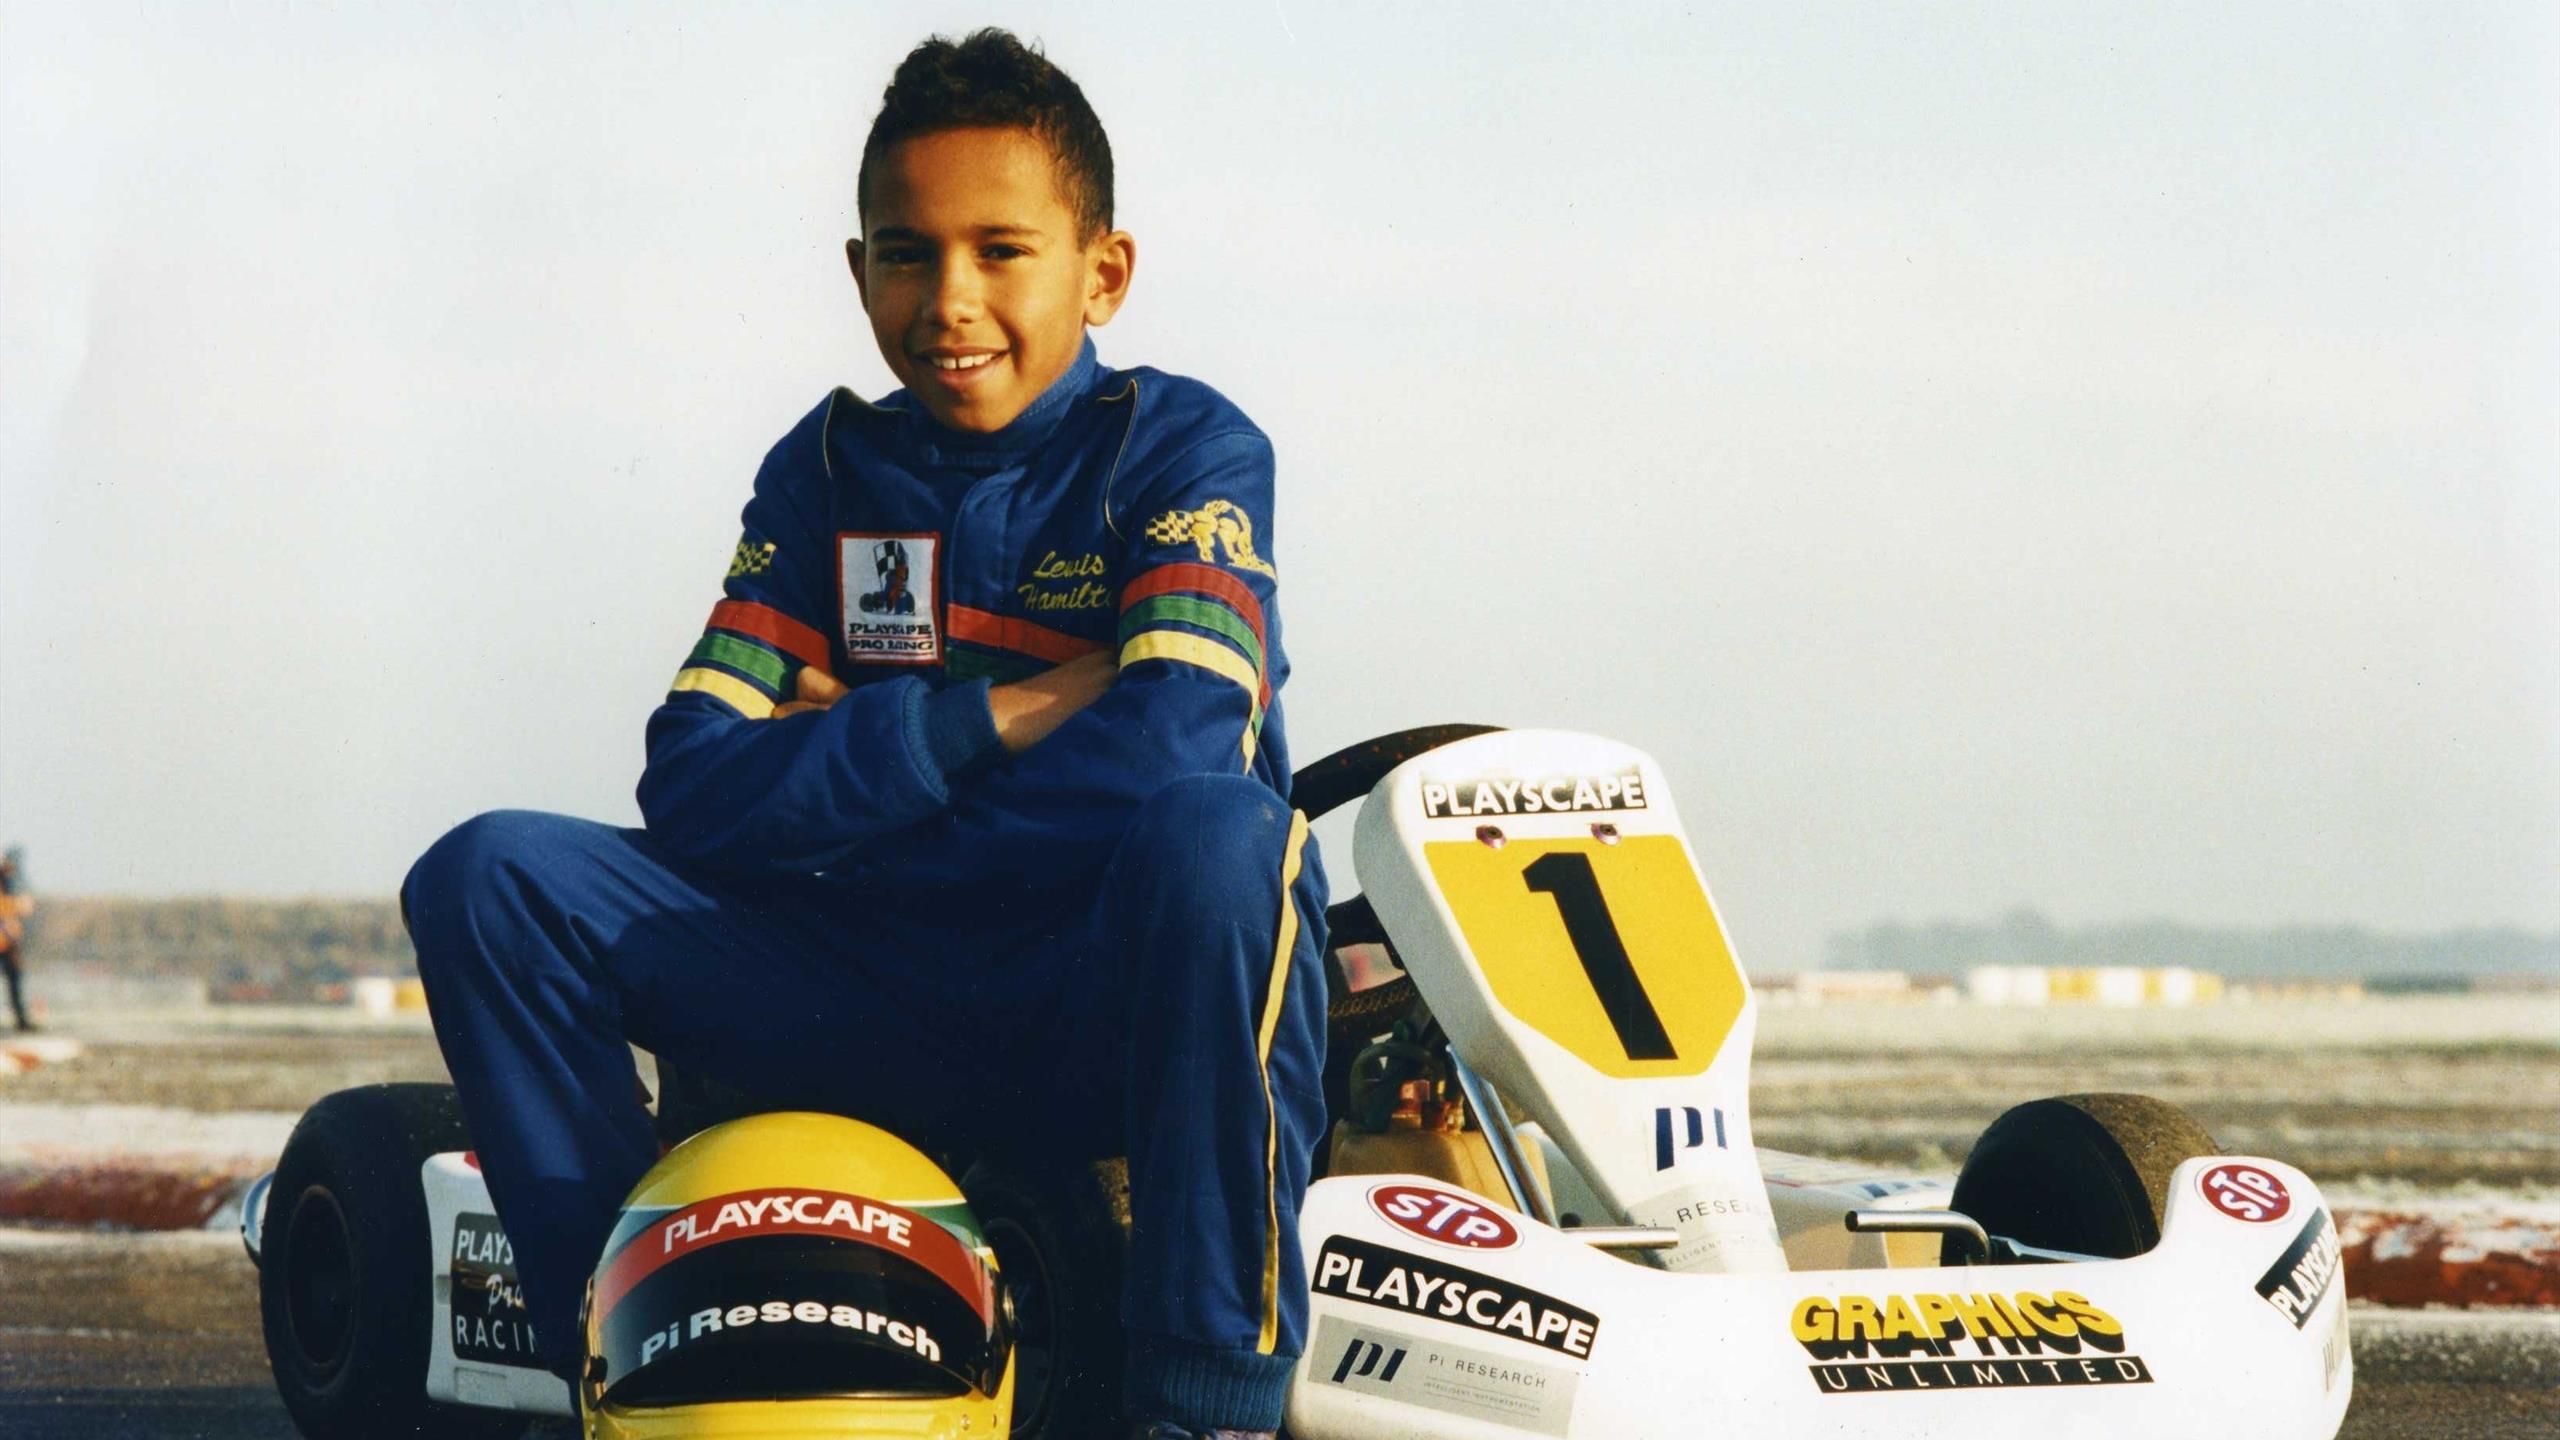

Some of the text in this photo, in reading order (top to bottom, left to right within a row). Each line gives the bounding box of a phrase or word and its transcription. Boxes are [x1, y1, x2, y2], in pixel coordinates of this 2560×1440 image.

[1032, 550, 1104, 578] Lewis
[849, 639, 884, 650] PRO
[1423, 775, 1645, 816] PLAYSCAPE
[1521, 852, 1679, 1060] 1
[1386, 1193, 1501, 1240] STP
[2209, 1170, 2279, 1220] STP
[664, 1196, 912, 1254] PLAYSCAPE
[1319, 1252, 1594, 1356] PLAYSCAPE
[1791, 1291, 2125, 1359] GRAPHICS
[641, 1300, 941, 1366] Pi Research
[1455, 1360, 1547, 1388] RESEARCH
[1822, 1359, 2141, 1391] UNLIMITED
